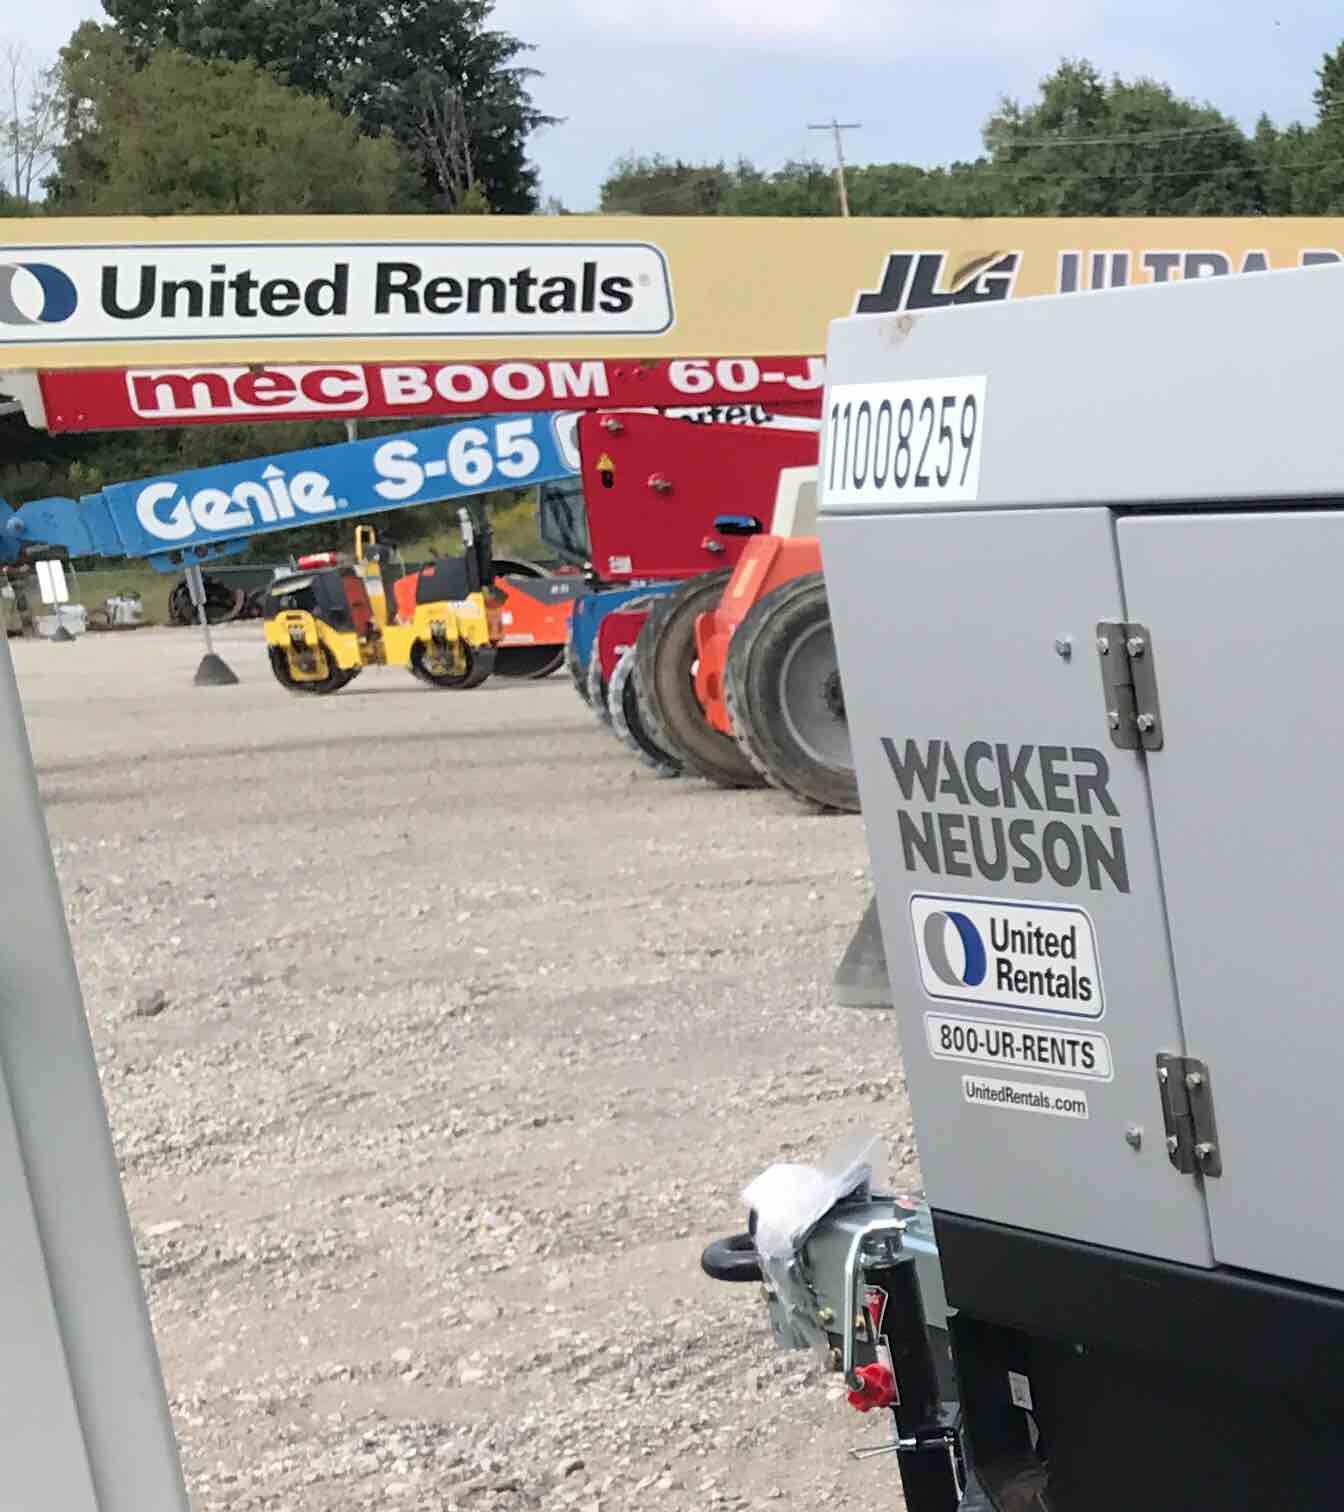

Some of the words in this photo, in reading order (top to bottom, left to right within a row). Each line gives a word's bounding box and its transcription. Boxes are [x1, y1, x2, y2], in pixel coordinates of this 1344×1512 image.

[101, 262, 350, 320] United
[374, 261, 634, 315] Rentals
[857, 253, 1018, 315] JLG
[131, 367, 366, 411] mec
[379, 361, 610, 405] BOOM
[828, 393, 978, 491] 11008259
[136, 463, 338, 540] Genie
[373, 418, 541, 501] S-65
[880, 737, 1121, 817] WACKER
[896, 808, 1131, 894] NEUSON
[990, 917, 1077, 960] United
[995, 958, 1092, 1002] Rentals
[940, 1023, 1096, 1069] 800-UR-RENTS
[965, 1080, 1087, 1114] UnitedRentals.com
